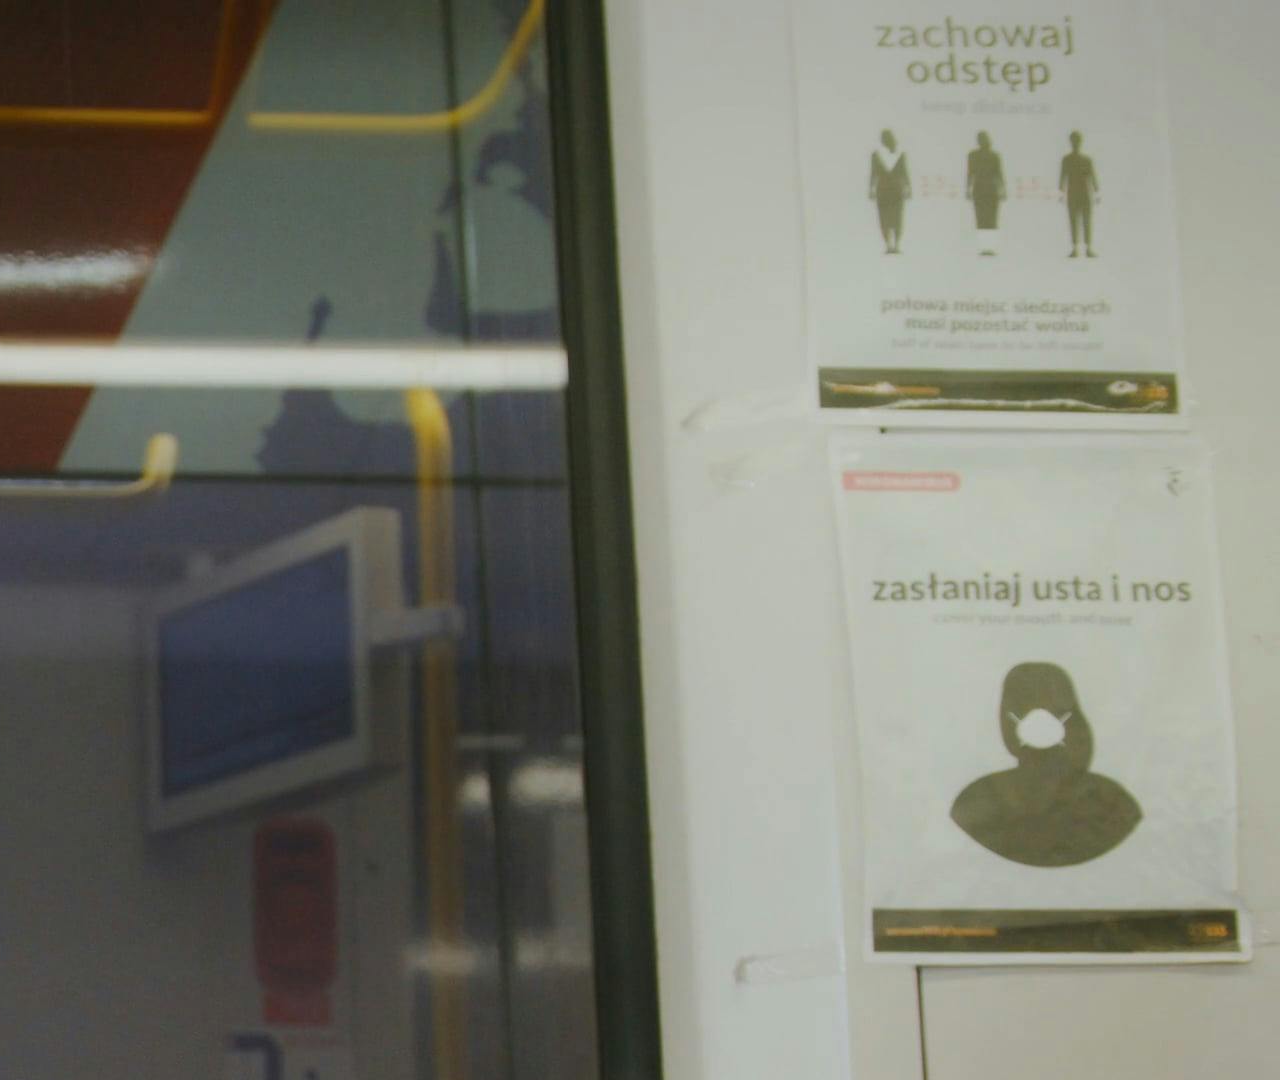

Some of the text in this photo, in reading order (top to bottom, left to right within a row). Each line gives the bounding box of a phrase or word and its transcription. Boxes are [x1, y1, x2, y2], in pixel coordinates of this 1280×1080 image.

[874, 16, 1074, 56] zachowaj
[906, 53, 1052, 92] odstęp
[873, 572, 1193, 608] zasłaniaj usta i nos
